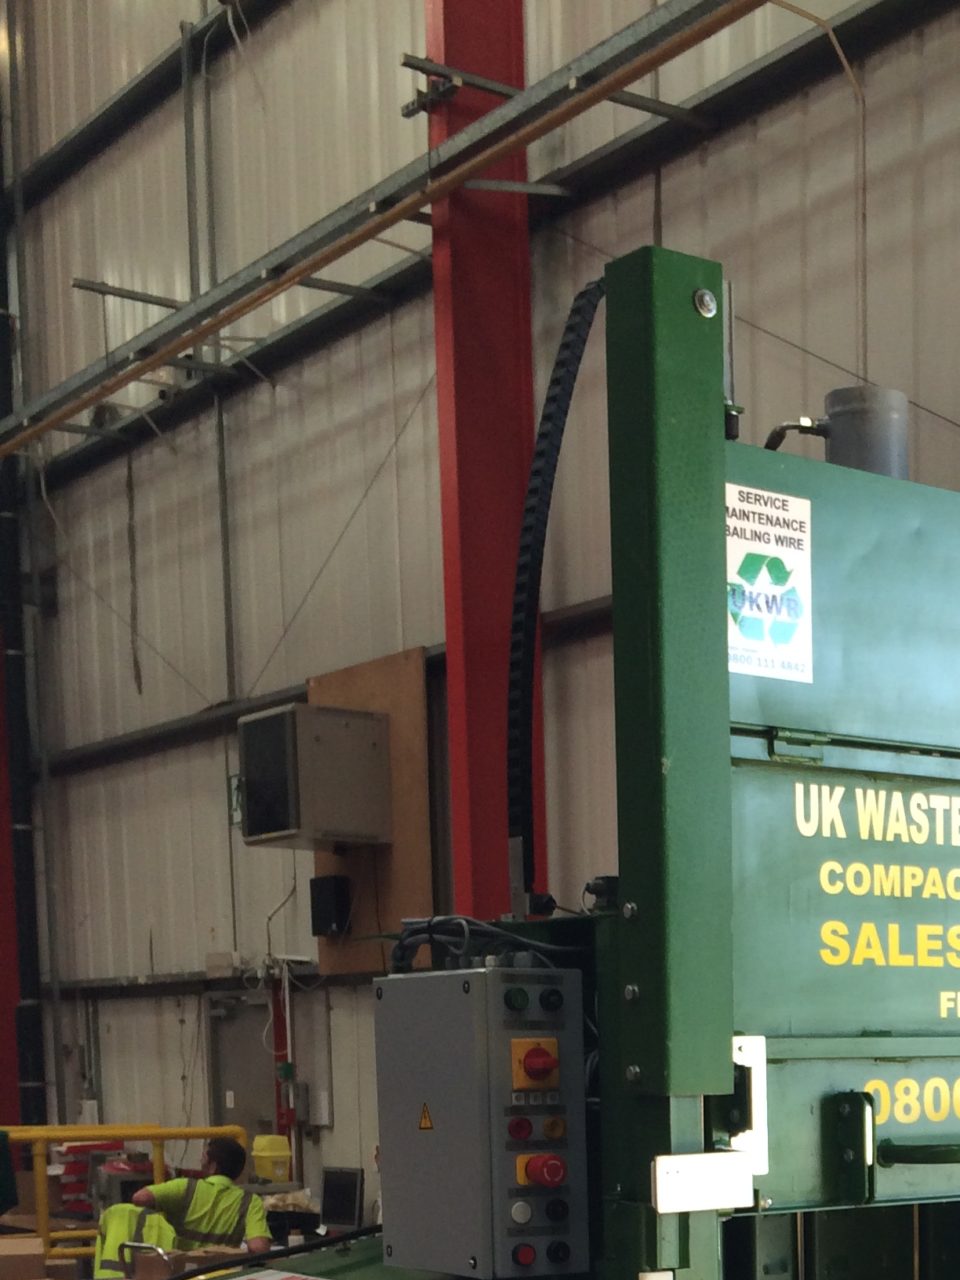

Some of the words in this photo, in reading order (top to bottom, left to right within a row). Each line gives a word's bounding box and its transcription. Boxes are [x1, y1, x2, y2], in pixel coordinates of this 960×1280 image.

[738, 490, 789, 512] SERVICE
[725, 525, 771, 545] BAILING
[774, 534, 805, 551] WIRE
[731, 588, 802, 619] UKWR
[794, 782, 847, 839] UK
